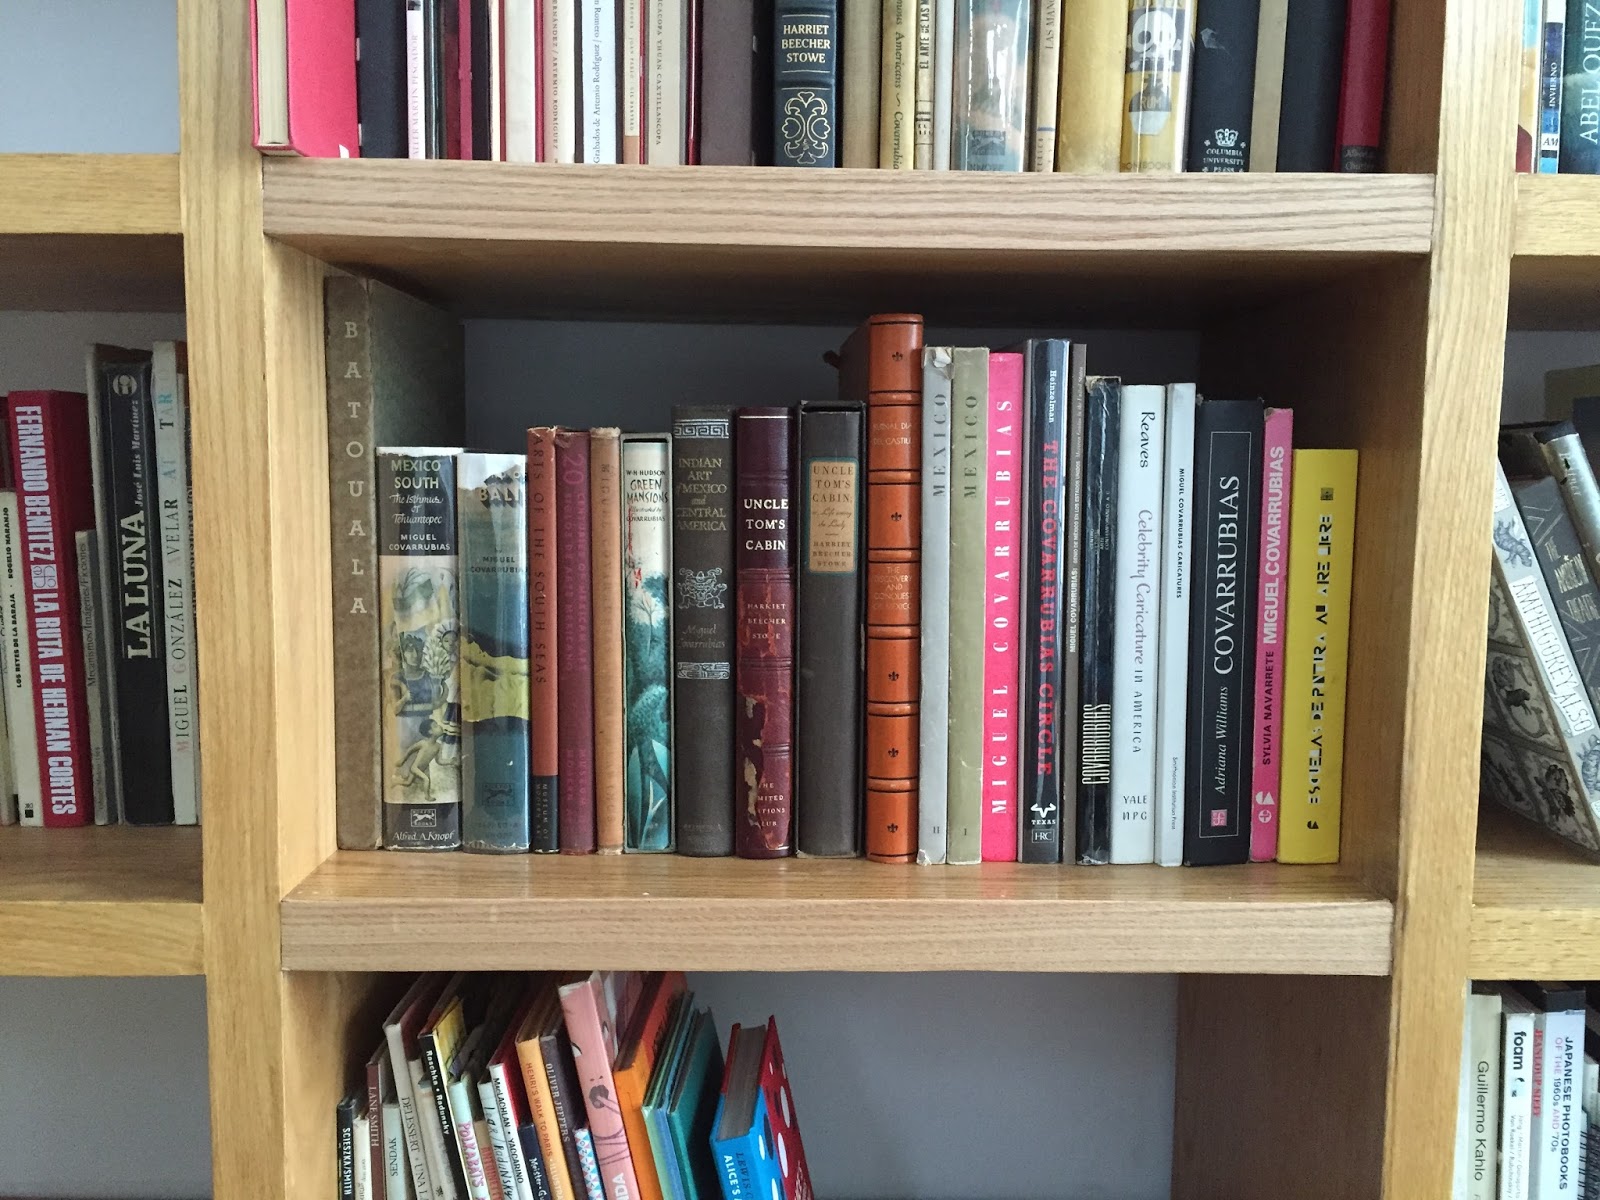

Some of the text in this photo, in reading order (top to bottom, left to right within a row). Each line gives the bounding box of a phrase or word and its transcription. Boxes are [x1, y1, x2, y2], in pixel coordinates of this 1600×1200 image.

[593, 7, 601, 38] Romero
[783, 24, 829, 36] HARRIET
[920, 8, 930, 69] EL ARTE LAS
[1045, 29, 1055, 49] LAS
[781, 39, 831, 50] BEECHER
[786, 52, 826, 64] STOWE
[894, 31, 905, 88] Americans
[592, 44, 603, 164] Grabados de Artemio Rodríguez
[1548, 62, 1558, 108] INVIERNO
[552, 100, 560, 149] RODRÍGUEZ
[1579, 81, 1600, 145] ABEL
[1203, 157, 1245, 166] UNIVERSITY
[1206, 148, 1243, 157] COLUMBIA
[1048, 369, 1058, 423] Heinzelman
[679, 458, 723, 469] INDIAN
[933, 394, 946, 497] MEXICO
[963, 395, 978, 499] MEXICO
[132, 454, 142, 478] Luis
[344, 321, 368, 614] BATOUALA
[391, 459, 441, 472] MEXICO
[394, 477, 439, 489] SOUTH
[630, 478, 662, 491] GREEN
[687, 471, 713, 481] ART
[813, 465, 854, 475] UNCLE
[815, 479, 851, 489] TOM'S
[134, 482, 143, 507] José
[389, 493, 444, 504] The Isthmus
[626, 491, 669, 504] MANSIONS
[682, 483, 728, 494] MEXICO
[743, 498, 790, 510] UNCLE
[391, 513, 443, 526] Tehuantepec
[411, 504, 422, 513] of
[676, 507, 727, 518] CENTRAL
[676, 521, 728, 531] AMERICA
[745, 519, 786, 530] TOM'S
[1176, 498, 1185, 550] COVARRUBIAS
[3, 507, 14, 579] ROGELIO NARANJO
[532, 437, 547, 683] ARTS OF THE SOUTH SEAS
[745, 540, 787, 550] CABIN
[1073, 540, 1079, 549] DE
[120, 510, 151, 659] LA LUNA
[1130, 412, 1156, 754] Reaves Celebrity Caricature AMERICA
[1175, 551, 1183, 599] CARICATURES
[9, 594, 18, 625] BARAJA
[15, 405, 76, 815] FERNANDO BENITEZ LA RUTA DE HERNAN CORTES
[991, 400, 1012, 814] MIGUEL COVARRUBIAS
[1037, 439, 1059, 775] THE COVARRUBIAS CIRCLE
[1070, 567, 1079, 623] COVARRUBIAS:
[1262, 446, 1285, 765] SYLVIA NAVARRETE MIGUEL COVARRUBIAS
[11, 626, 19, 637] LA
[13, 637, 20, 647] DE
[168, 578, 187, 674] GONZÁLEZ
[1069, 624, 1078, 653] MIGUEL
[1214, 475, 1240, 795] Adriana Williams COVARRUBIAS
[1511, 582, 1580, 689] AMPHIGOREY
[1553, 692, 1594, 732] ALSO
[1081, 703, 1112, 785] COVARRUBIAS
[1122, 795, 1148, 804] YALE
[392, 831, 416, 841] Alfred
[1512, 1031, 1527, 1070] foam
[1533, 1029, 1544, 1085] JEANLOUP
[1554, 1037, 1563, 1052] OF
[1554, 1055, 1563, 1075] THE
[426, 1050, 450, 1135] Raschka Radunsky
[525, 1062, 553, 1157] HENRI'S WALK TO PARIS
[545, 1062, 570, 1142] OLIVER JEFFERS
[1552, 1077, 1562, 1106] 1960s
[369, 1086, 380, 1147] LANE SMITH
[1474, 1060, 1490, 1181] Guillermo Kahlo
[1551, 1108, 1560, 1129] AND
[1559, 1036, 1574, 1190] JAPANESE PHOTOBOOKS
[342, 1127, 353, 1195] SCIESZKA/SMITH
[389, 1137, 399, 1177] SENDAK
[401, 1096, 426, 1188] DELESSERT UNA
[508, 1137, 524, 1184] YACCARINO
[723, 1154, 742, 1196] ALICE'S
[735, 1152, 752, 1190] LEWIS
